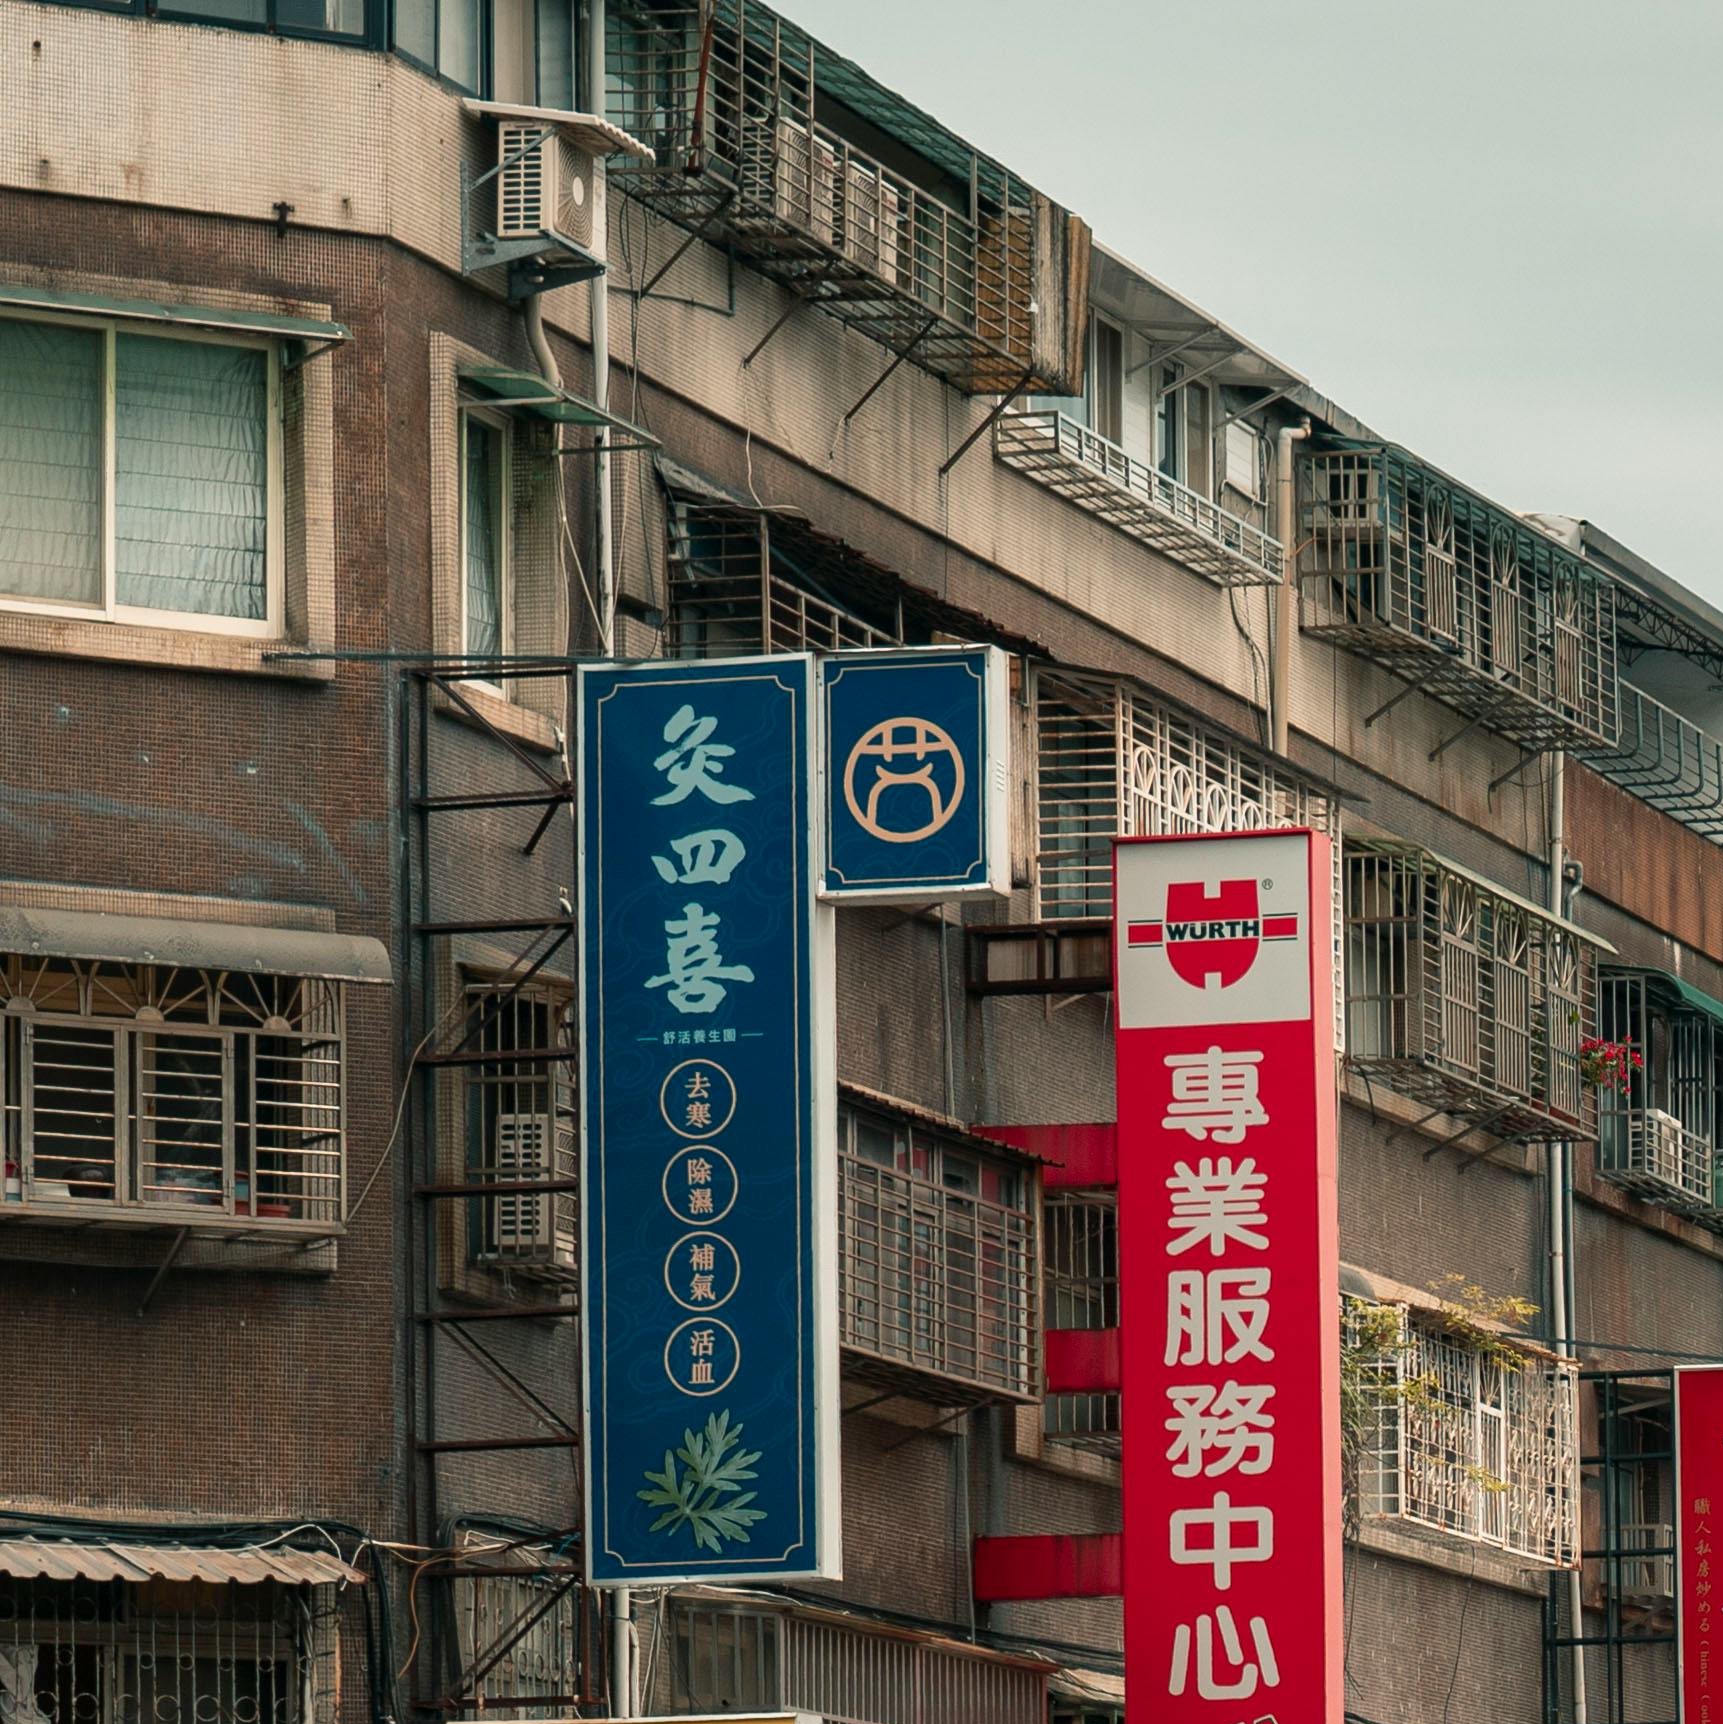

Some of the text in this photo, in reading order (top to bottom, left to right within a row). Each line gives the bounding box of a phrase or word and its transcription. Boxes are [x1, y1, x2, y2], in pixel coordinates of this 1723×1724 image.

[644, 704, 756, 1013] 灸四喜
[685, 1071, 712, 1128] 去寒
[689, 1243, 717, 1302] 補氣
[688, 1329, 716, 1385] 活血
[1161, 1045, 1281, 1702] 專業服務中心
